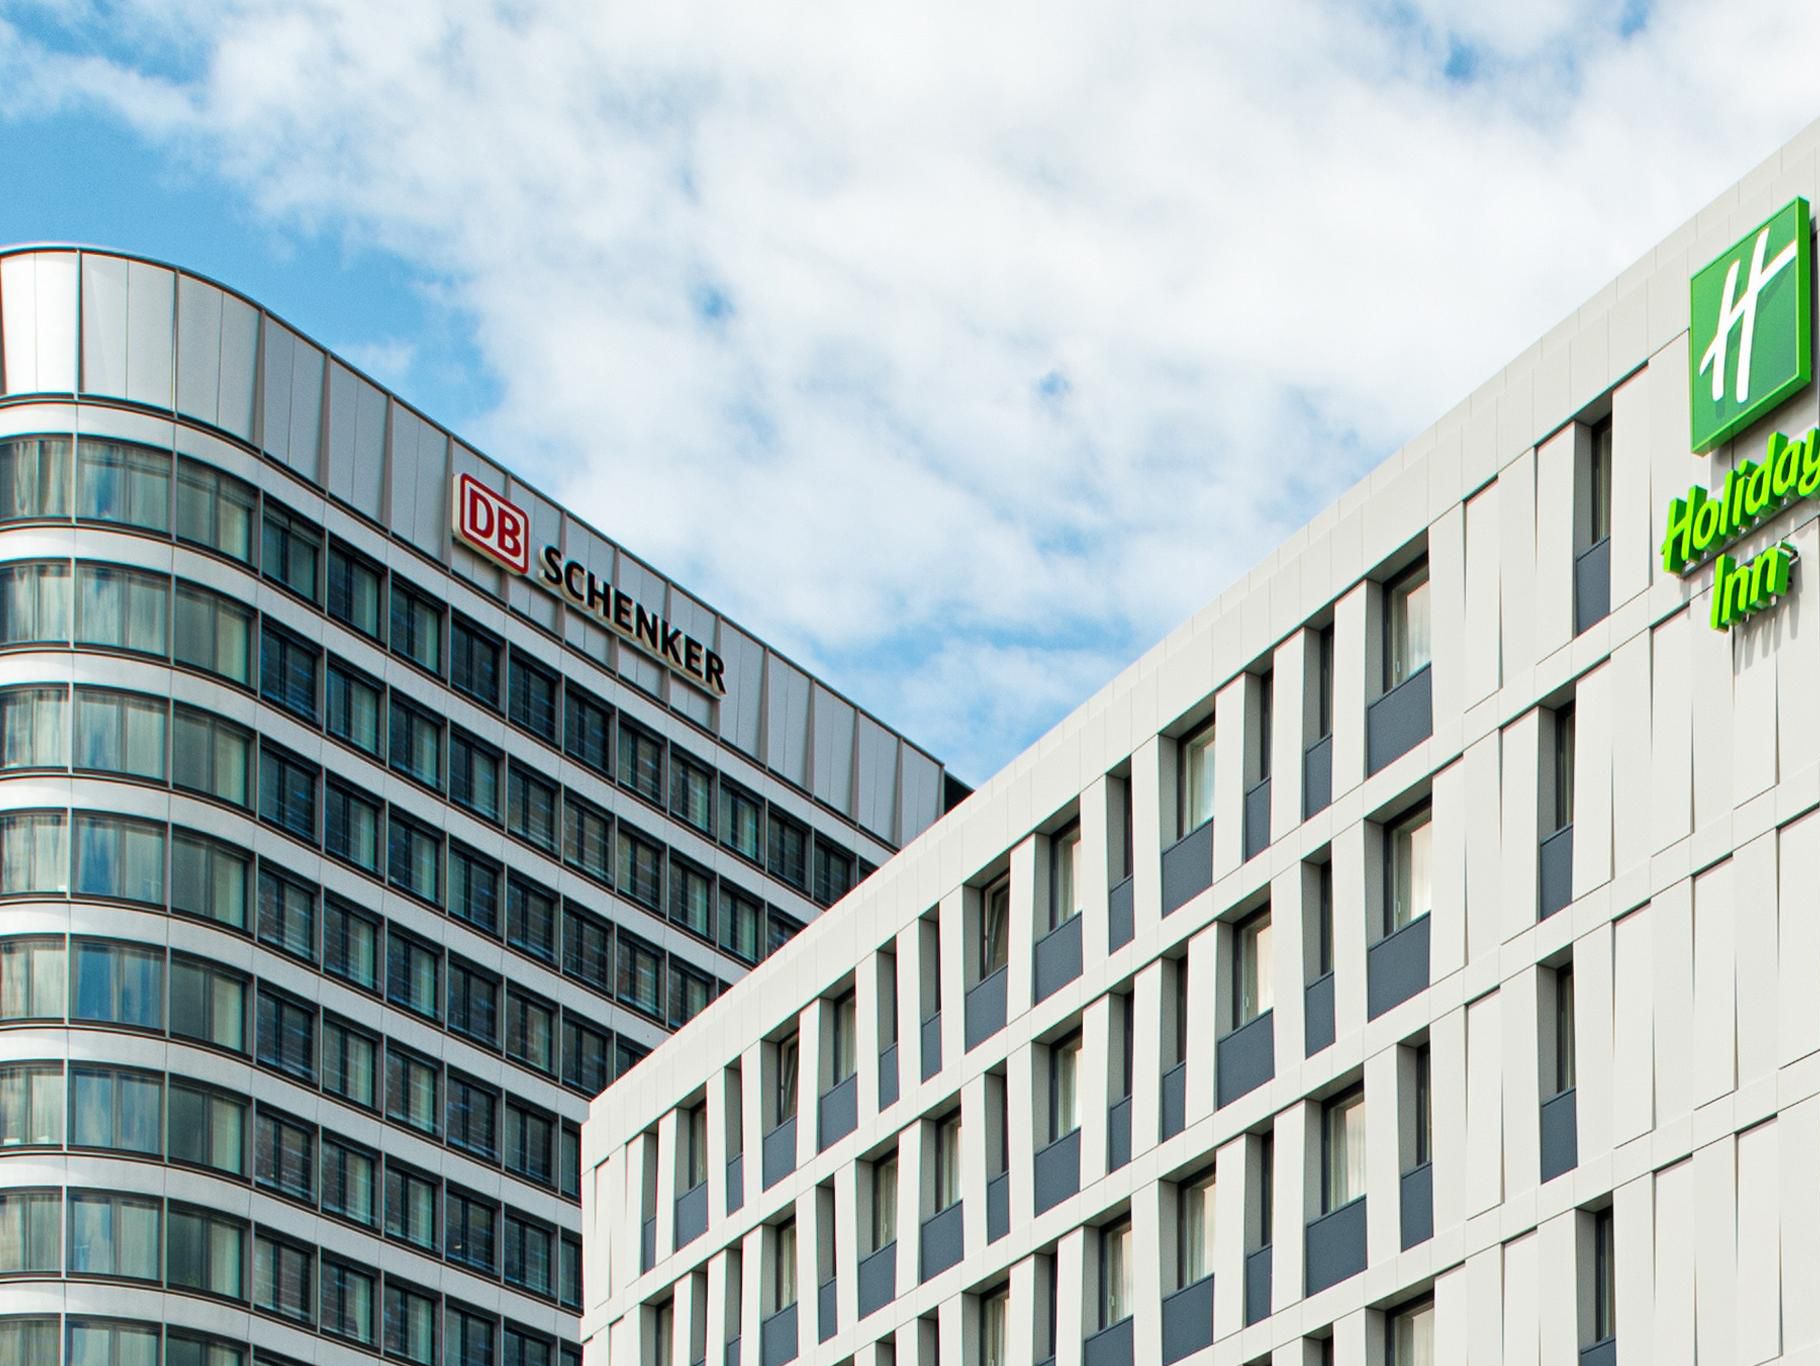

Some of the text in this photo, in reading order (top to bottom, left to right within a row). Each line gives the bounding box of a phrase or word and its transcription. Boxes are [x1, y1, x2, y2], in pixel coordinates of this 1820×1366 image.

[468, 486, 727, 696] DB SCHENKER
[1710, 543, 1796, 633] Inn
